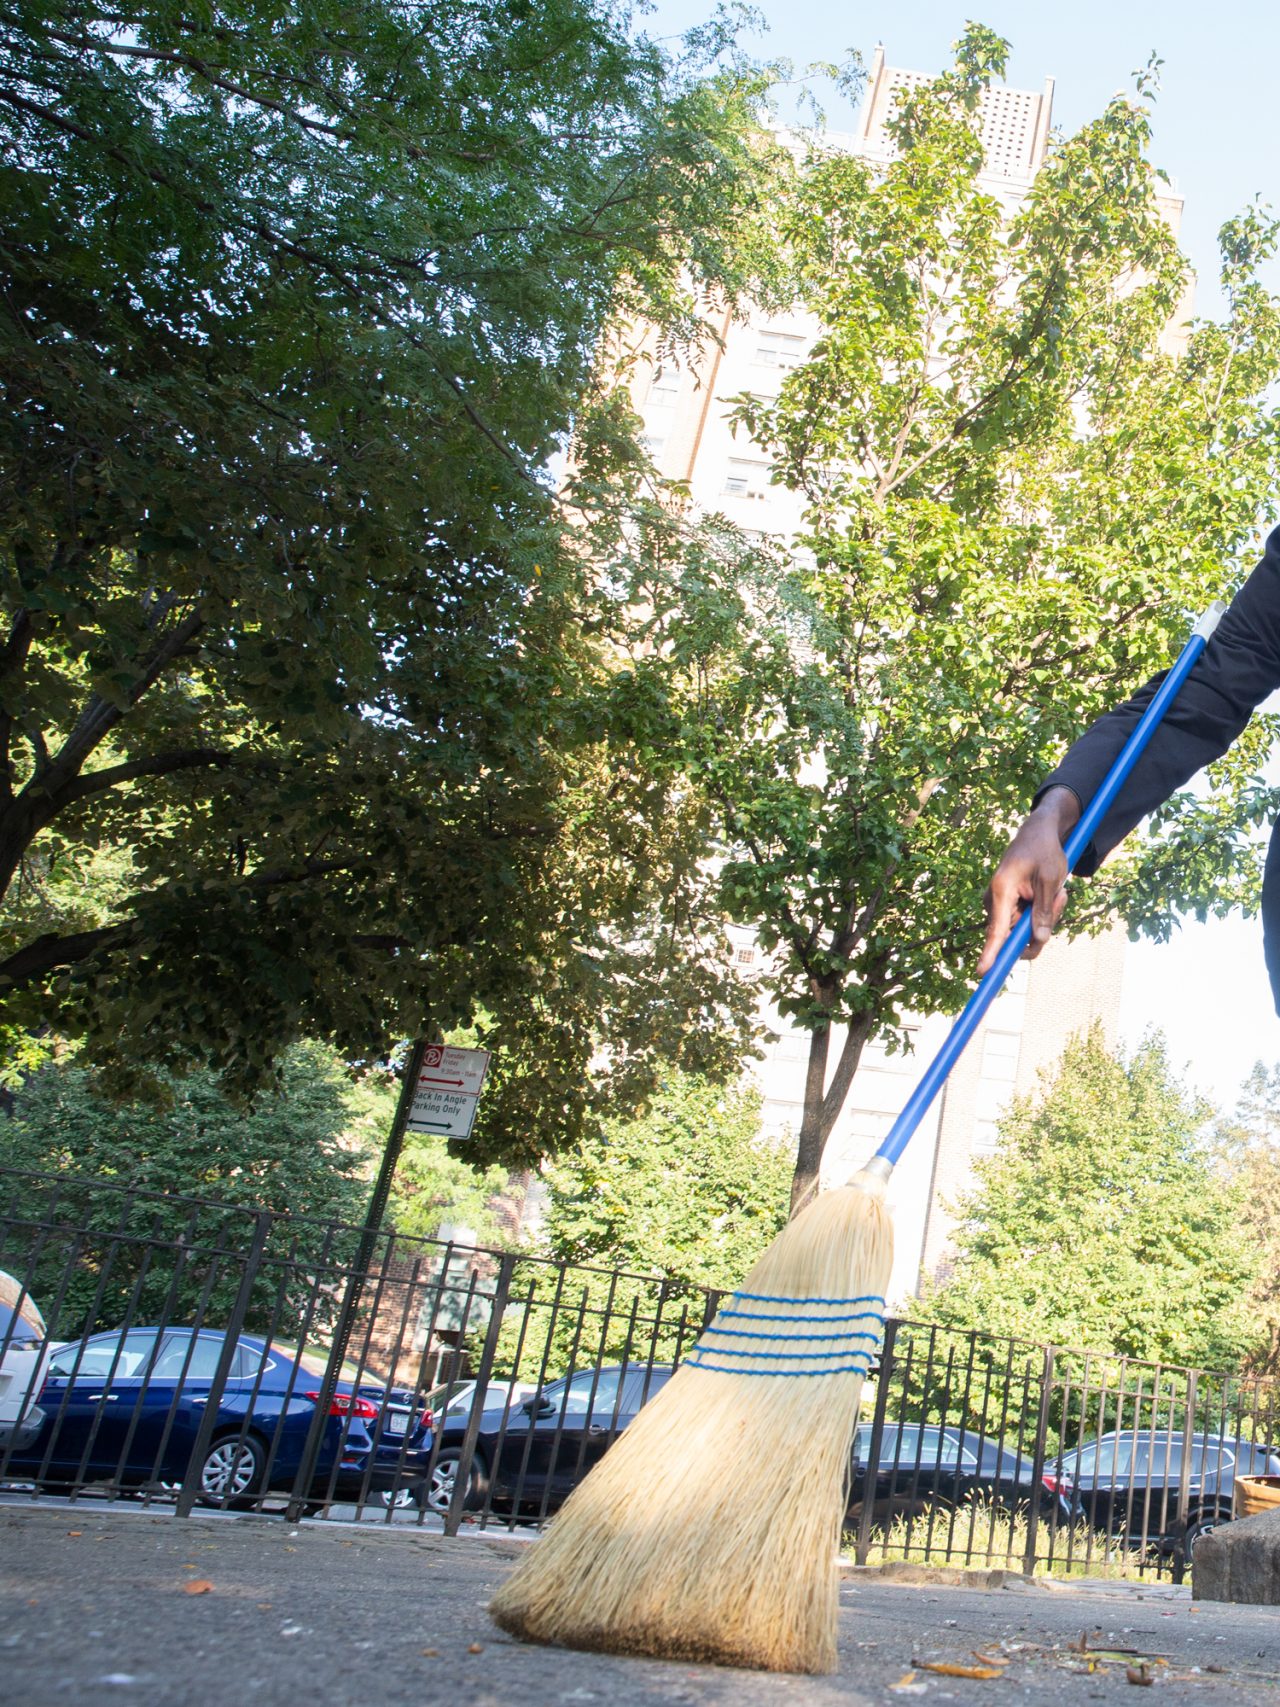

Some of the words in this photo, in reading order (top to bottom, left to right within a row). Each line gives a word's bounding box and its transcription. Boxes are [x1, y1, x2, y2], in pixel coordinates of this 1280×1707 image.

[414, 1090, 432, 1100] Back
[434, 1092, 443, 1101] In
[444, 1093, 467, 1105] Angle
[411, 1101, 440, 1113] Parking
[442, 1103, 461, 1116] Only
